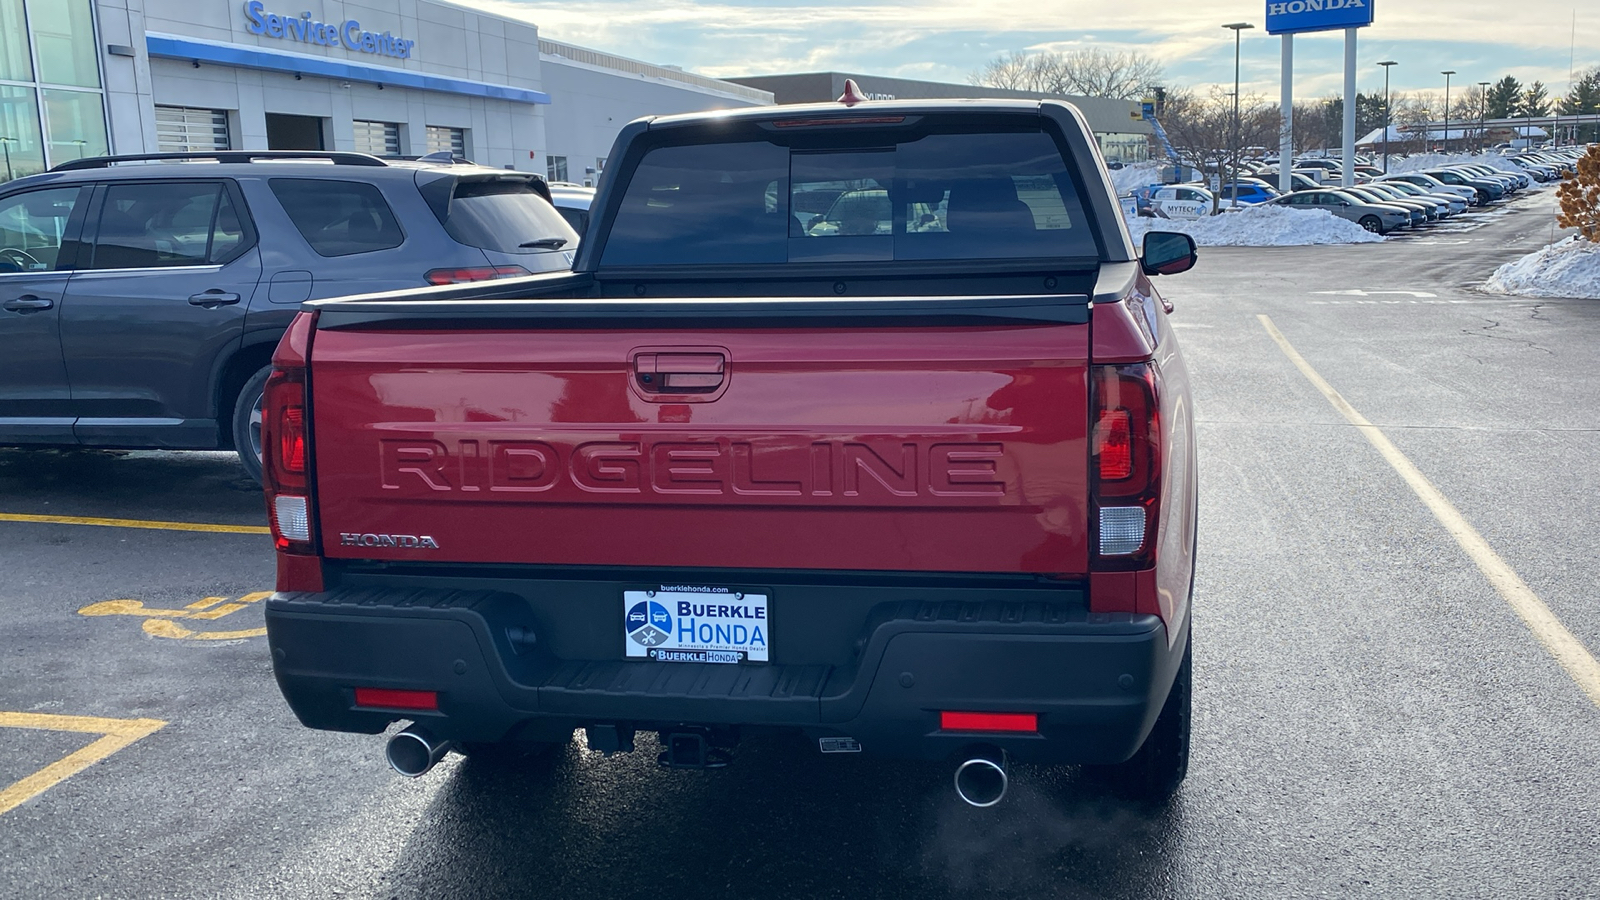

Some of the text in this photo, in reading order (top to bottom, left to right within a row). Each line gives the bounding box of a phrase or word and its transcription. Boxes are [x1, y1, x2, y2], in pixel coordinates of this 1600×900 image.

[1268, 0, 1366, 16] HONDA
[243, 0, 415, 59] Service Center
[379, 438, 1006, 497] RIDGELINE
[340, 532, 440, 549] HONDA
[660, 584, 729, 594] buerklehonda.com
[677, 601, 765, 619] BUERKLE
[677, 618, 766, 646] HONDA
